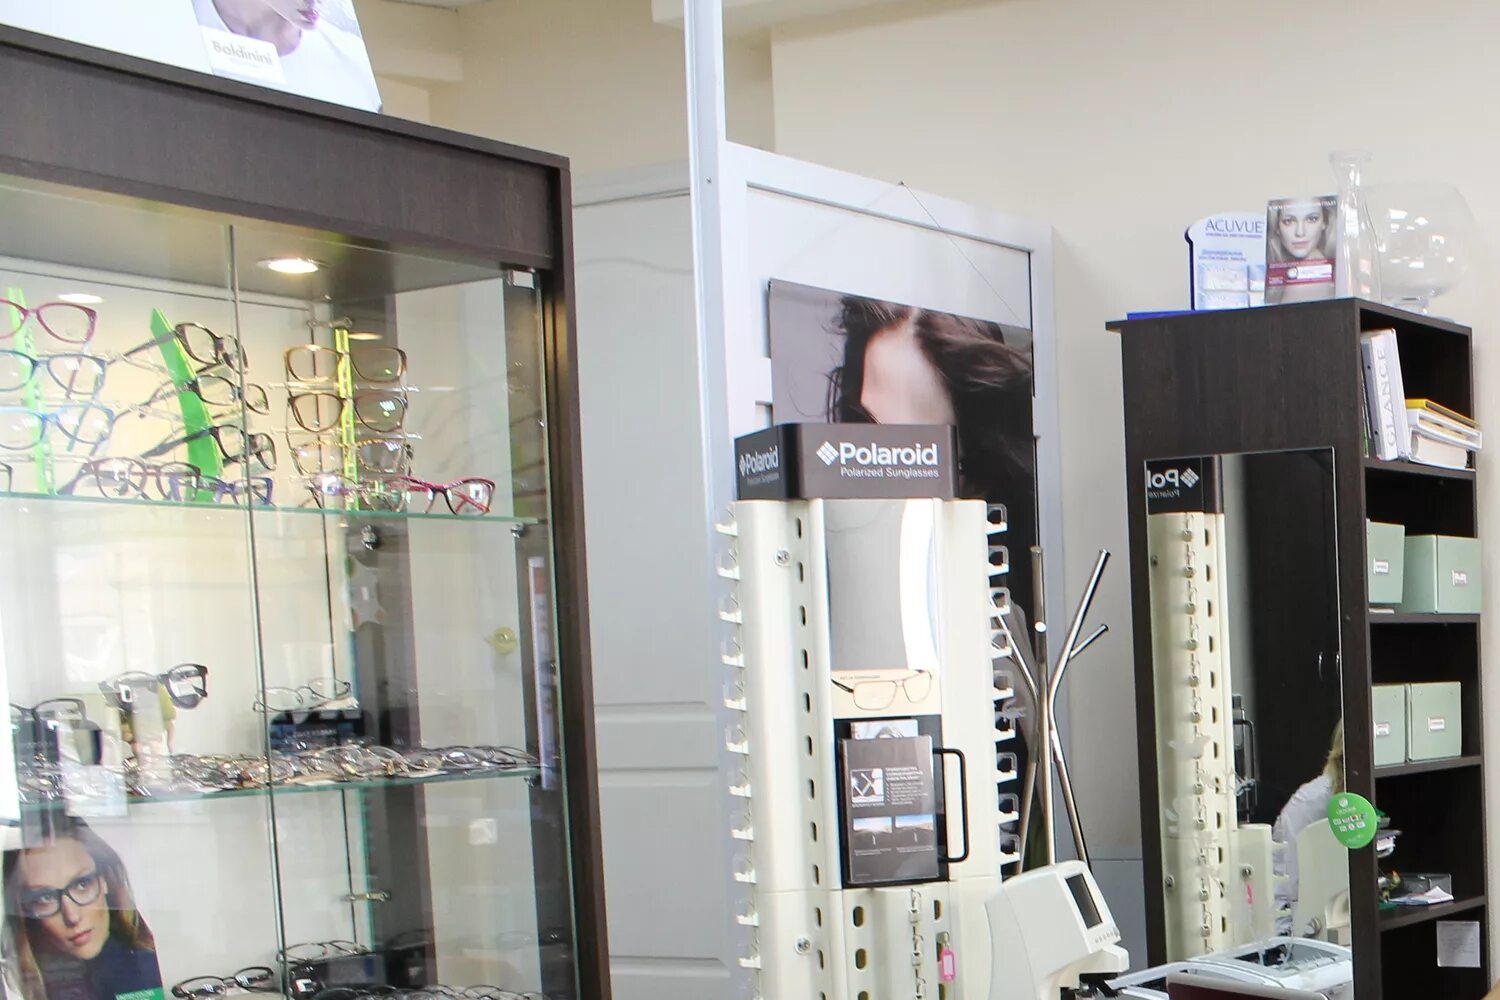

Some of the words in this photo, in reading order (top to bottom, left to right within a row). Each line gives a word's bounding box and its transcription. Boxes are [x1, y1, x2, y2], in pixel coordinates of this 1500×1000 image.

[1206, 219, 1263, 233] ACUVUE
[1378, 348, 1398, 447] GLANCE
[745, 447, 778, 475] Polaroid
[840, 442, 938, 466] Polaroid
[841, 467, 883, 477] Polarized
[886, 467, 939, 480] Sunglasses
